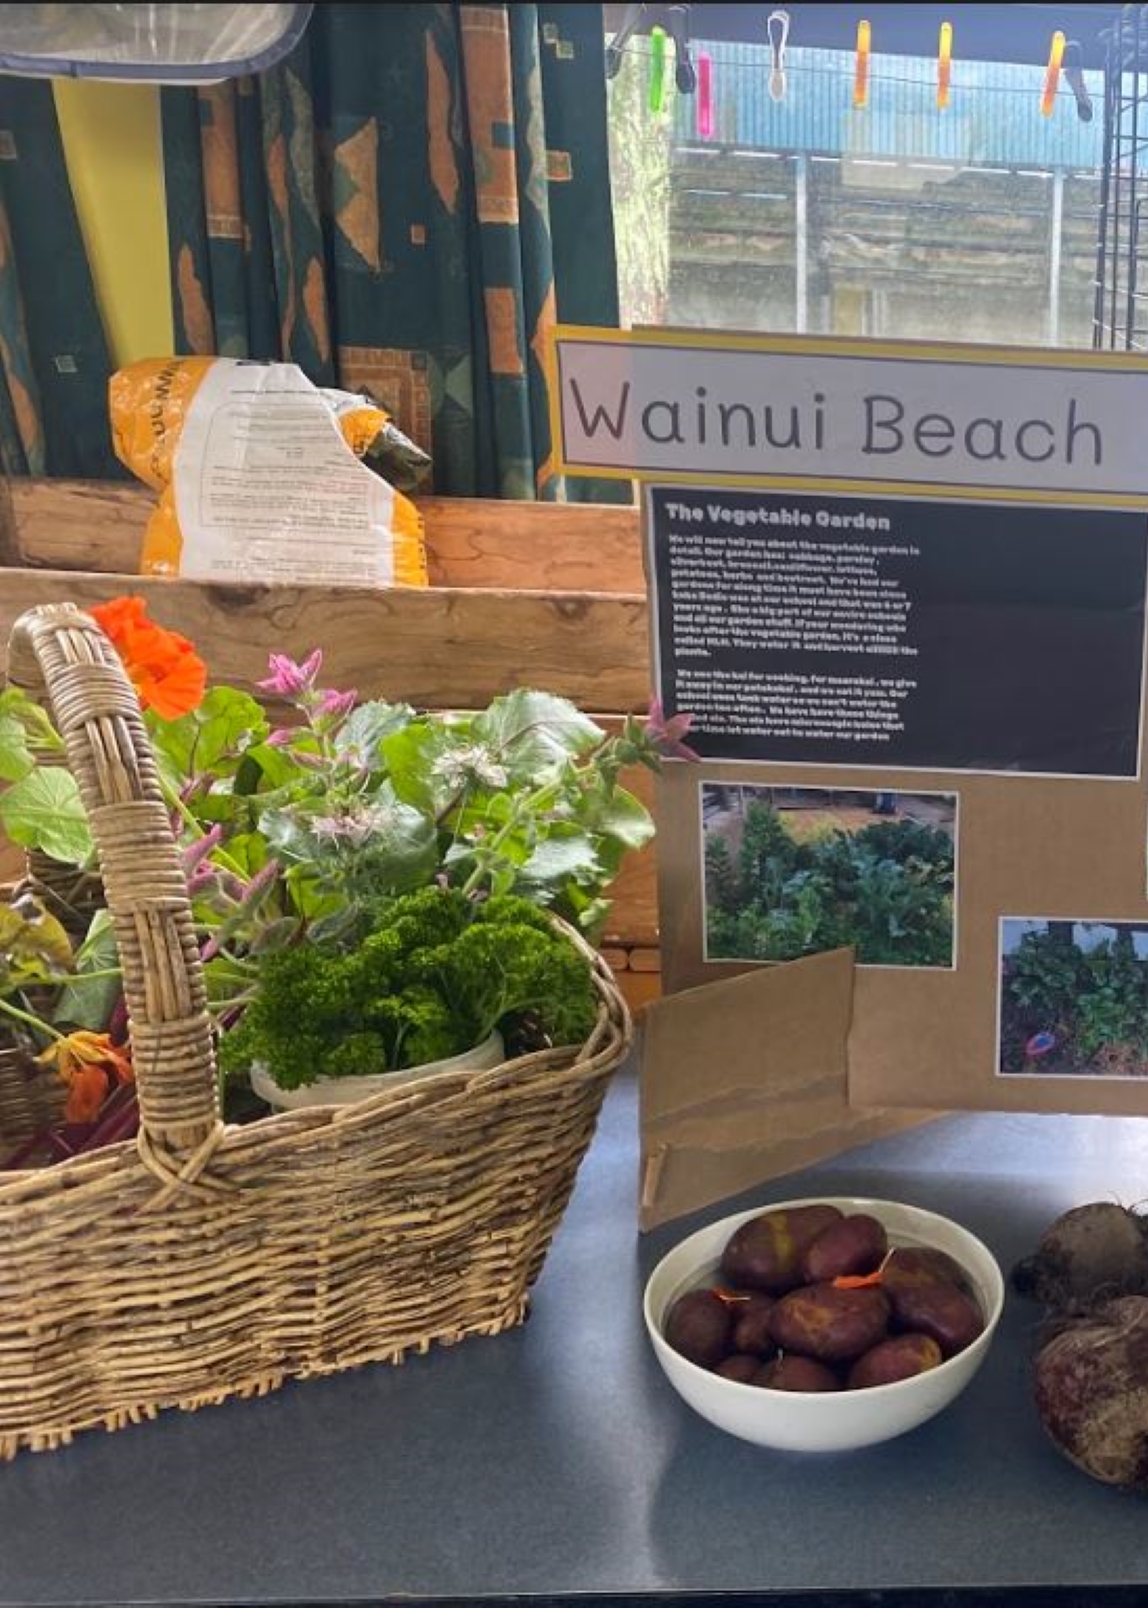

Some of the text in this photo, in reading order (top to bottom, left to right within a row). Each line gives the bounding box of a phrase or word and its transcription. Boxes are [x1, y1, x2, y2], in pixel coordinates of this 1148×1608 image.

[570, 378, 825, 451] Wainui
[862, 394, 1102, 466] Beach
[664, 503, 890, 530] The Vegetable Garden
[704, 547, 723, 556] Our
[725, 549, 762, 558] garden
[746, 539, 766, 548] you
[767, 540, 797, 549] about
[819, 542, 869, 552] vegetable
[872, 546, 908, 555] garden
